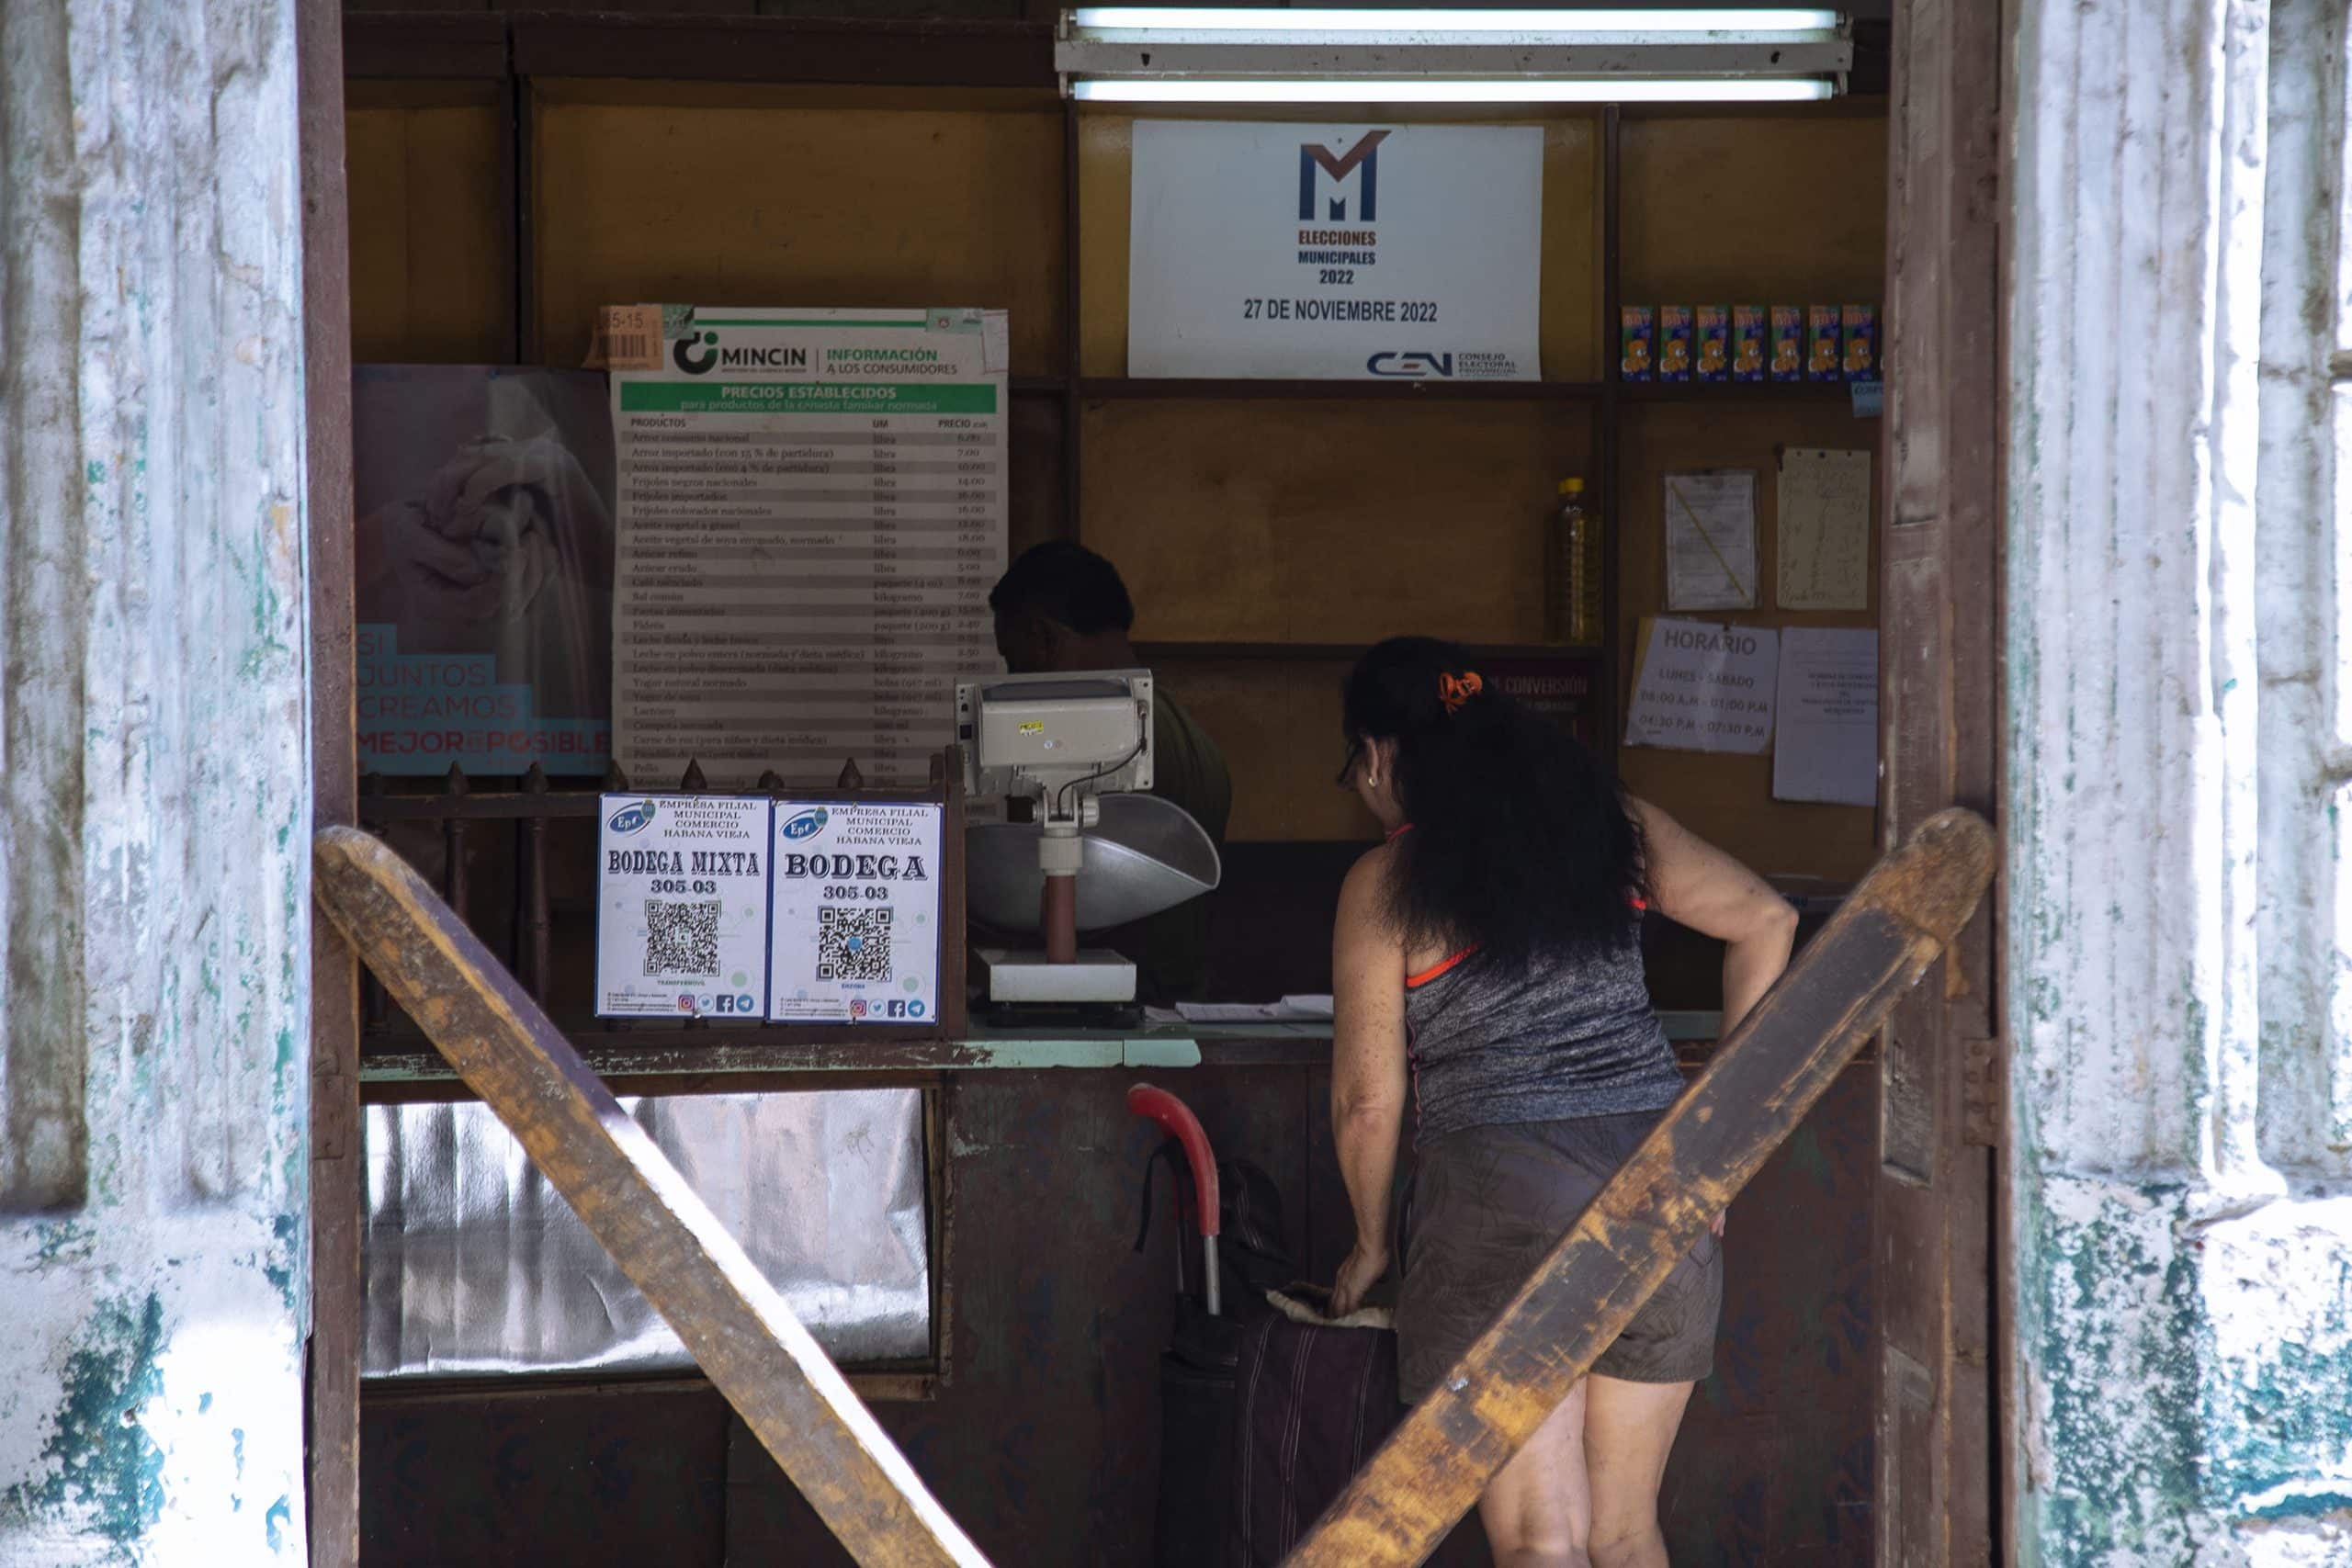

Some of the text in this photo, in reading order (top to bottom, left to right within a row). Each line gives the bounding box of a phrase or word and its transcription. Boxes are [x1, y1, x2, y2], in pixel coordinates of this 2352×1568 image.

[1298, 231, 1376, 246] ELECCIONES
[1298, 251, 1376, 265] MUNICIPALES
[1319, 270, 1354, 285] 2022
[1244, 299, 1438, 322] 27 DE NOVIEMBRE 2022
[721, 347, 807, 367] MINCIN
[826, 347, 938, 362] INFORMACIÓN
[1459, 353, 1506, 361] CONSEJO
[827, 363, 957, 375] A LOS CONSUMIDORES
[721, 387, 897, 400] PRECIOS ESTABLECIDOS
[681, 401, 710, 412] para
[713, 400, 765, 412] productos
[768, 400, 783, 411] de
[630, 418, 686, 429] PRODUCTOS
[872, 420, 889, 429] UM
[938, 419, 971, 428] PRECIO
[356, 633, 384, 656] SI
[1664, 628, 1758, 656] HORARIO
[357, 662, 486, 688] JUNTOS
[1658, 668, 1696, 683] LUNES
[1506, 672, 1588, 695] CONVERSIÓN
[357, 694, 516, 719] CREAMOS
[356, 730, 464, 754] MEJOR
[487, 730, 610, 754] POSIBLE
[660, 800, 757, 810] EMPRESA FILIAL
[674, 810, 741, 819] MUNICIPAL
[831, 807, 929, 818] EMPRESA FILIAL
[675, 820, 740, 829] COMERCIO
[846, 818, 913, 827] MUNICIPAL
[664, 829, 750, 839] HABANA VIEJA
[848, 828, 910, 836] COMERCIO
[837, 836, 922, 846] HABANA VIEJA
[608, 851, 761, 876] BODEGA MIXTA
[785, 853, 928, 881] BODEGA
[650, 879, 717, 894] 305.03
[823, 886, 888, 900] 305.03
